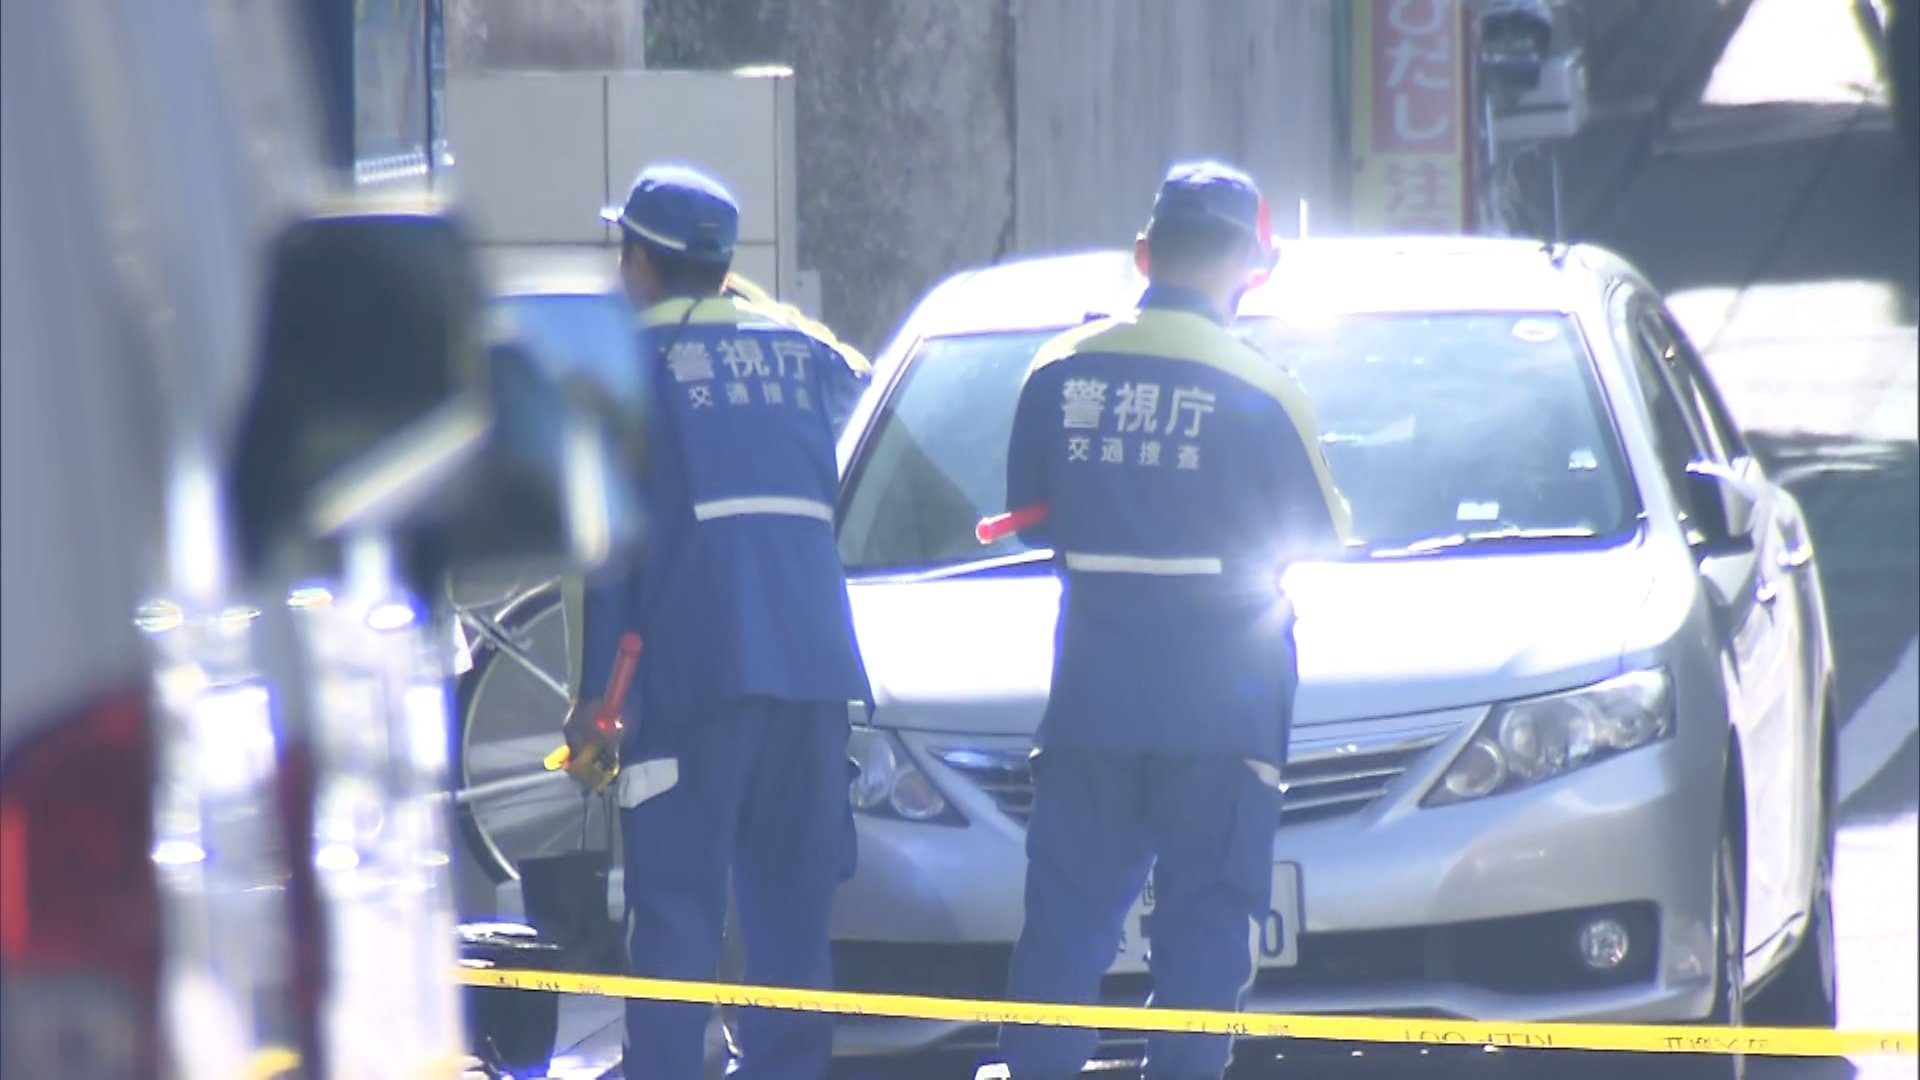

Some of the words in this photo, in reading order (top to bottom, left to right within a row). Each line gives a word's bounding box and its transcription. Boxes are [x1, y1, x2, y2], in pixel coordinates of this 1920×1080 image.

[662, 338, 811, 381] 警視庁
[1061, 377, 1217, 439] 警視庁
[1067, 436, 1201, 471] 交通捜査
